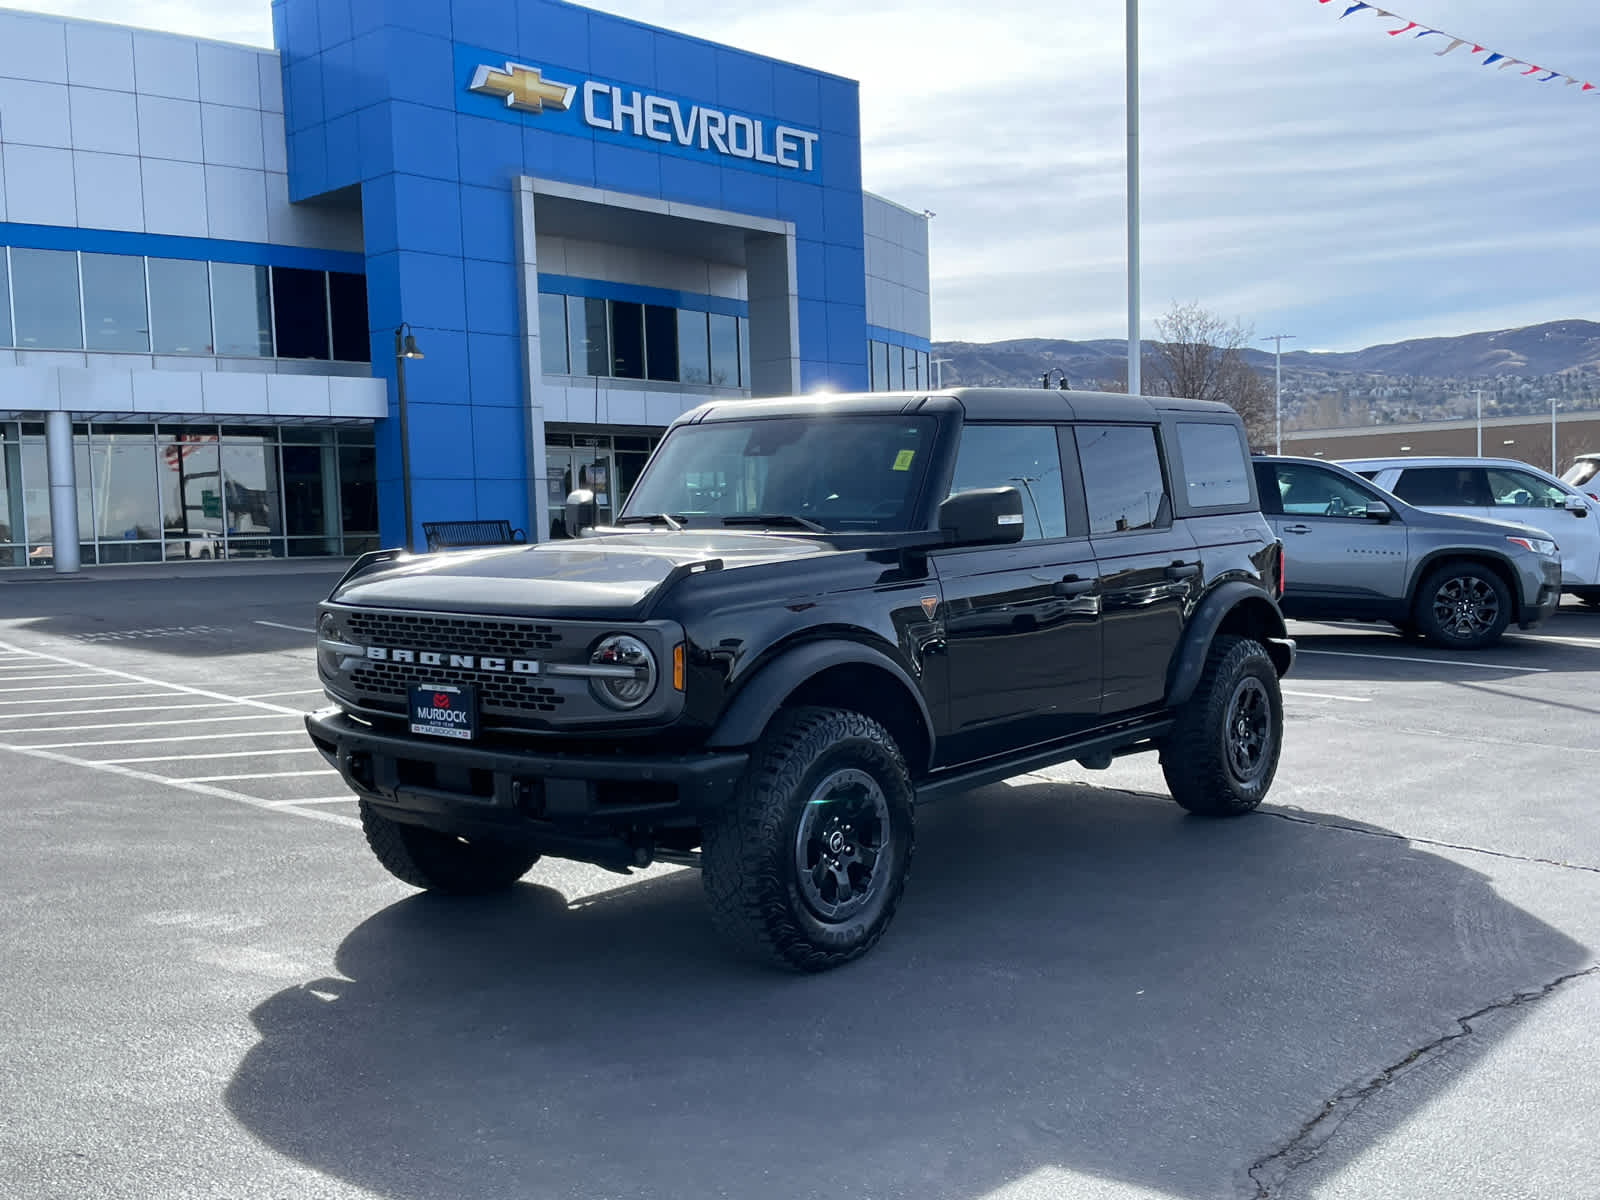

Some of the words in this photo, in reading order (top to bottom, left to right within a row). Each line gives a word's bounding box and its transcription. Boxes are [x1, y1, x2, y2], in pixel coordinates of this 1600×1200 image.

[583, 80, 819, 171] CHEVROLET
[367, 646, 540, 674] BRONCO
[417, 706, 467, 723] MURDOCK
